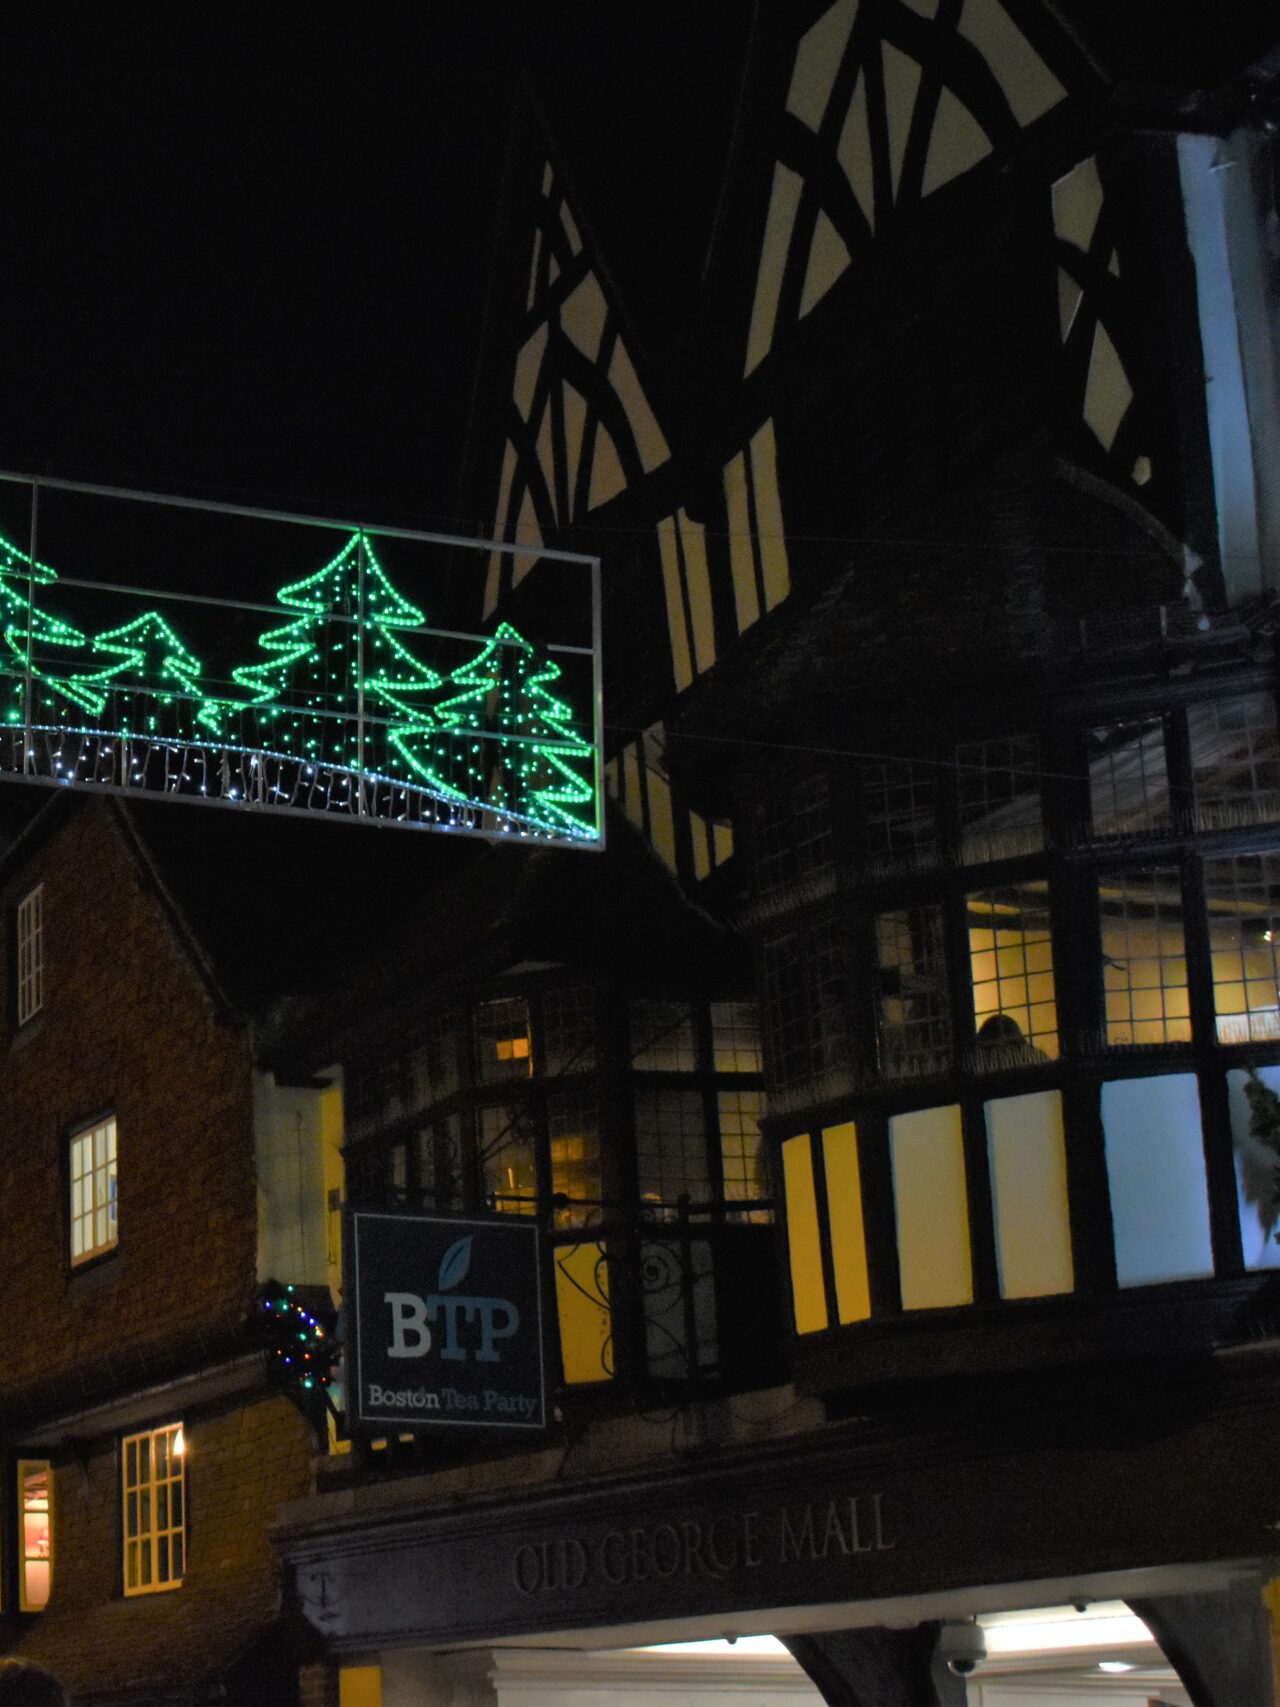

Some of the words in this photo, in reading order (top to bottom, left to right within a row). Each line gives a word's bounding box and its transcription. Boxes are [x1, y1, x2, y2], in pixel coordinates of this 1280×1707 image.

[384, 1292, 520, 1362] BTP
[368, 1384, 441, 1410] Boston
[442, 1388, 480, 1411] Tea
[482, 1389, 537, 1419] Party
[513, 1539, 588, 1595] OLD
[600, 1511, 762, 1584] GEORGE
[779, 1493, 896, 1563] MALL
